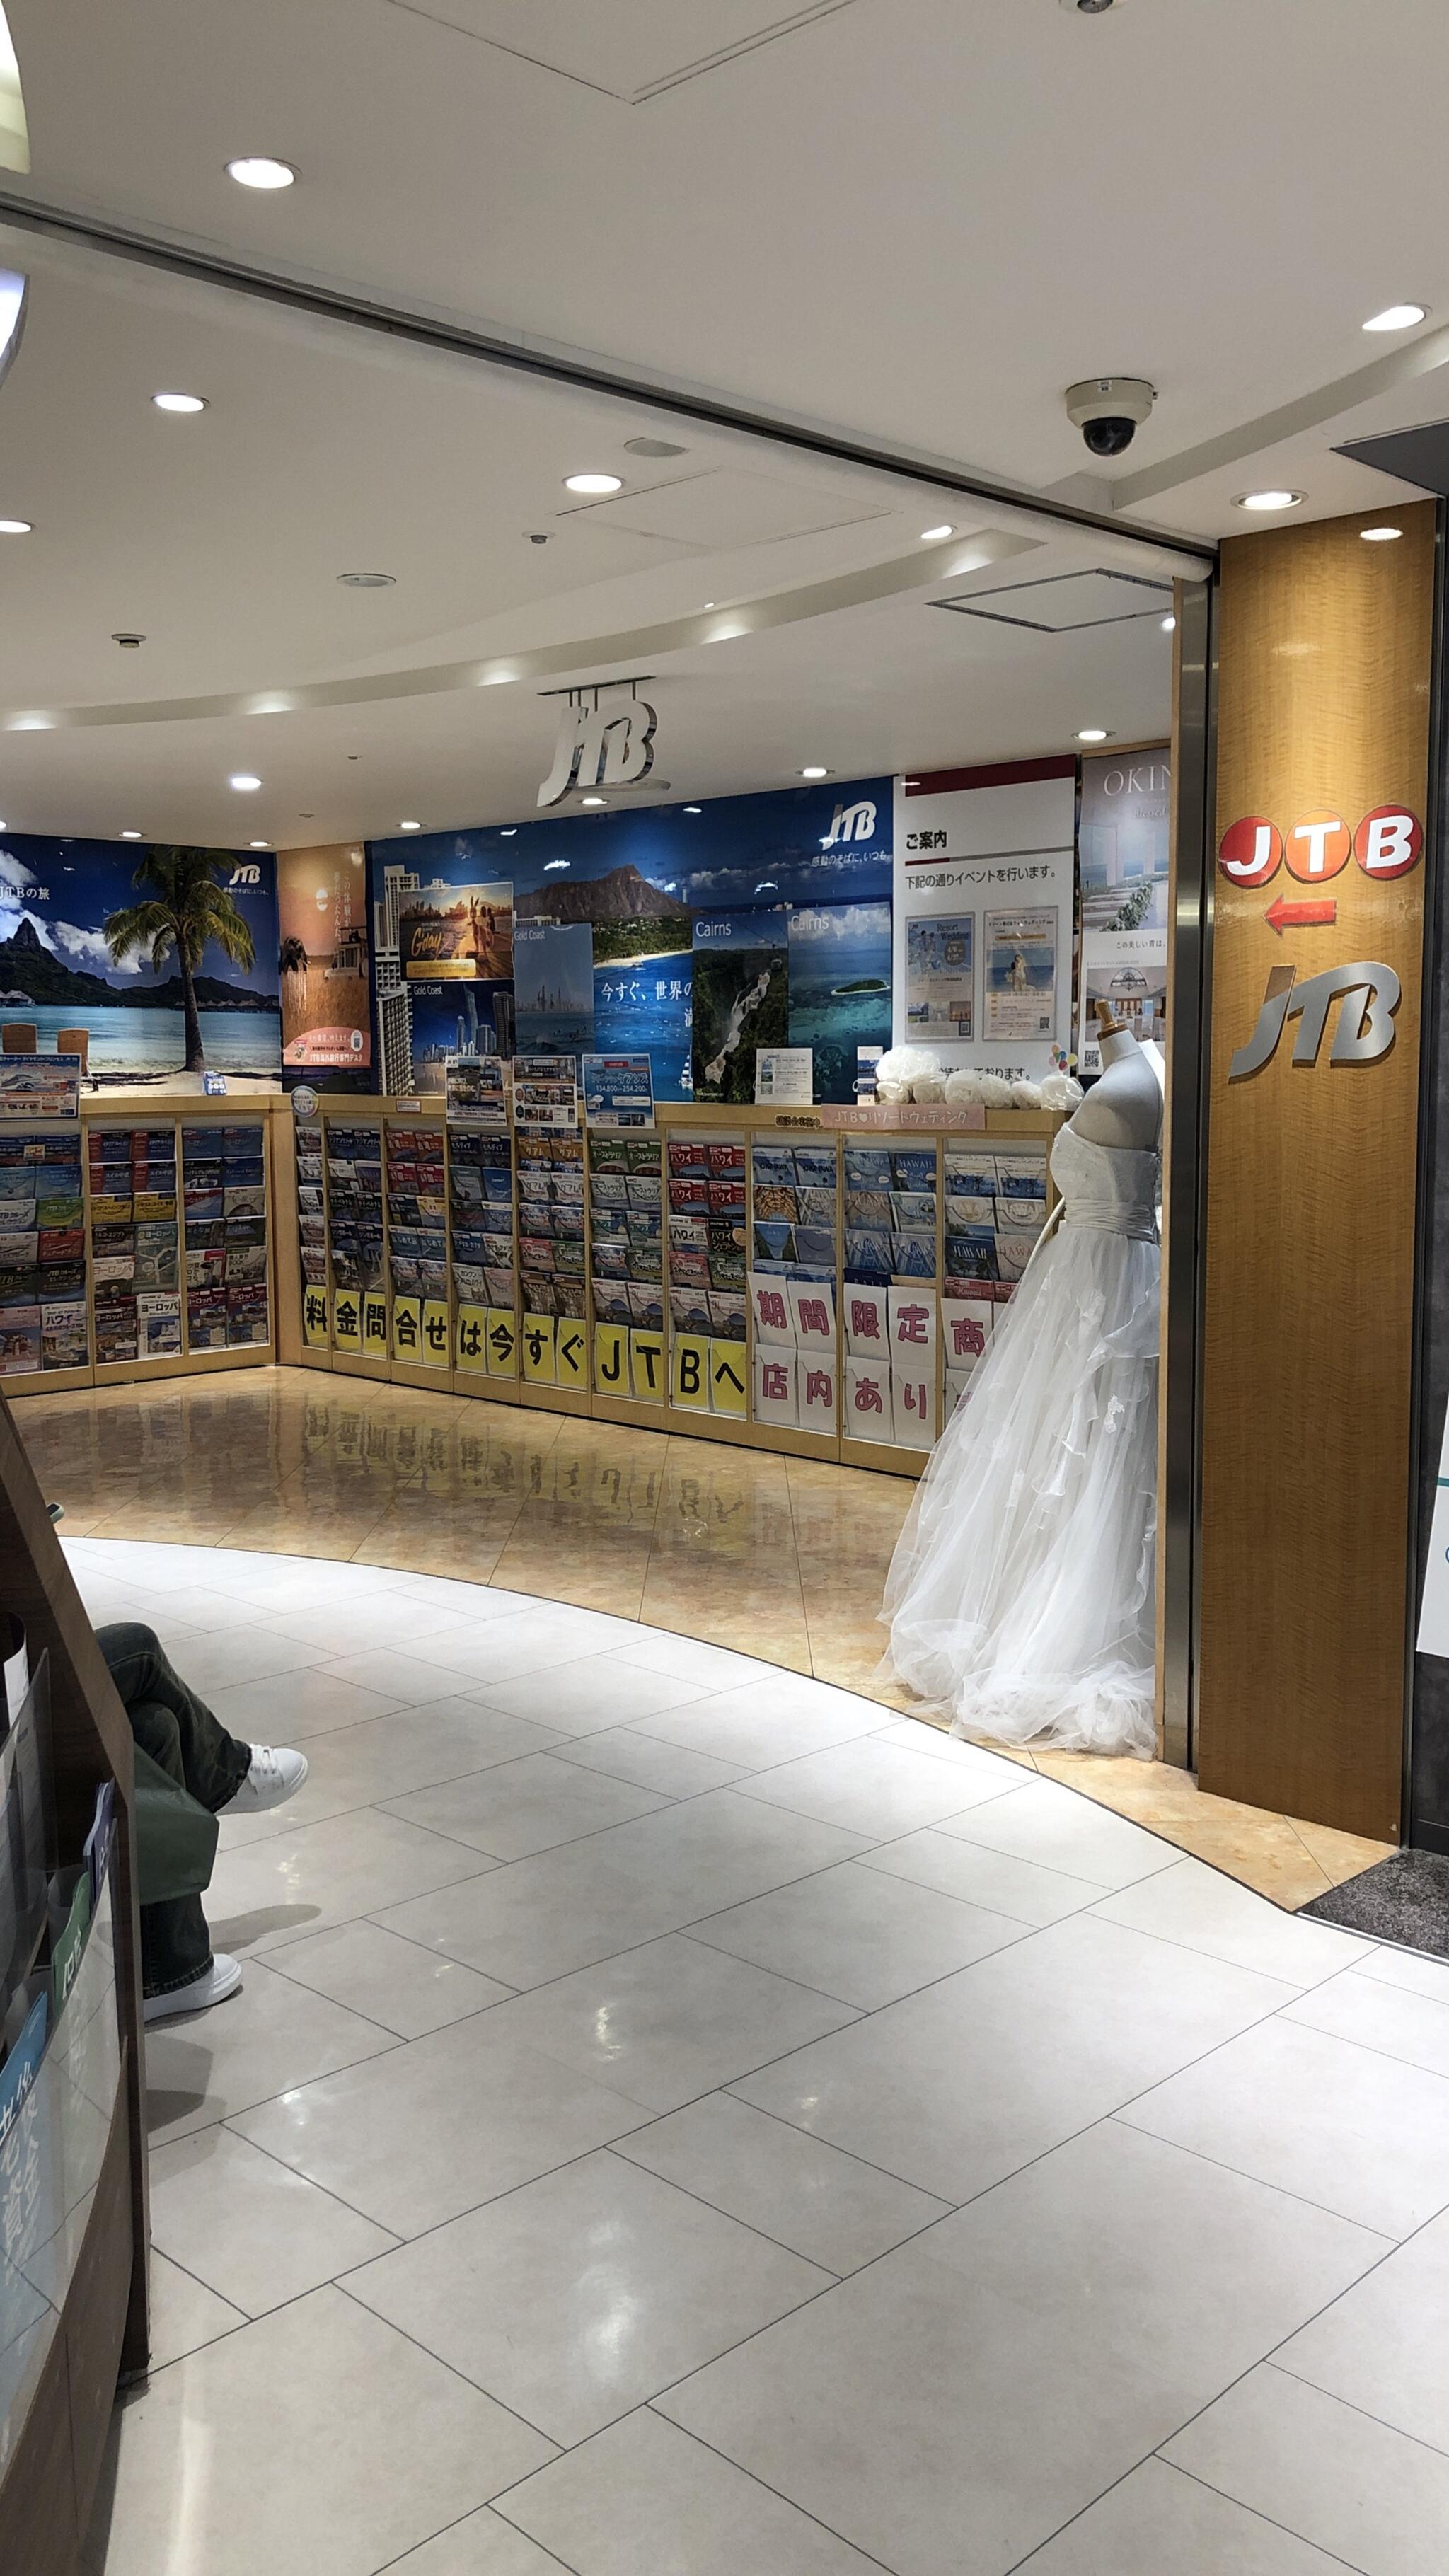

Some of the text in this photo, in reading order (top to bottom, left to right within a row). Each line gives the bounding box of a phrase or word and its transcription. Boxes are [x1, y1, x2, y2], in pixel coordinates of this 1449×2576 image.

[536, 699, 657, 807] JTB
[822, 801, 877, 850] JTB
[906, 830, 947, 850] ご案内
[1227, 814, 1414, 876] JTB
[229, 865, 261, 886] JTB
[905, 865, 1056, 889] 下記の通りイベントを行います。
[696, 921, 732, 937] Cairns
[791, 915, 829, 931] Cairns
[514, 930, 545, 941] Gold Coast
[414, 986, 443, 995] Gold Coast
[1228, 961, 1401, 1085] JTB
[671, 1153, 691, 1163] ハワイ
[711, 1155, 732, 1165] ハワイ
[671, 1189, 691, 1200] ハワイ
[710, 1192, 732, 1203] ハワイ
[140, 1303, 178, 1312] ヨーロッパ
[762, 1363, 972, 1420] 店内あり
